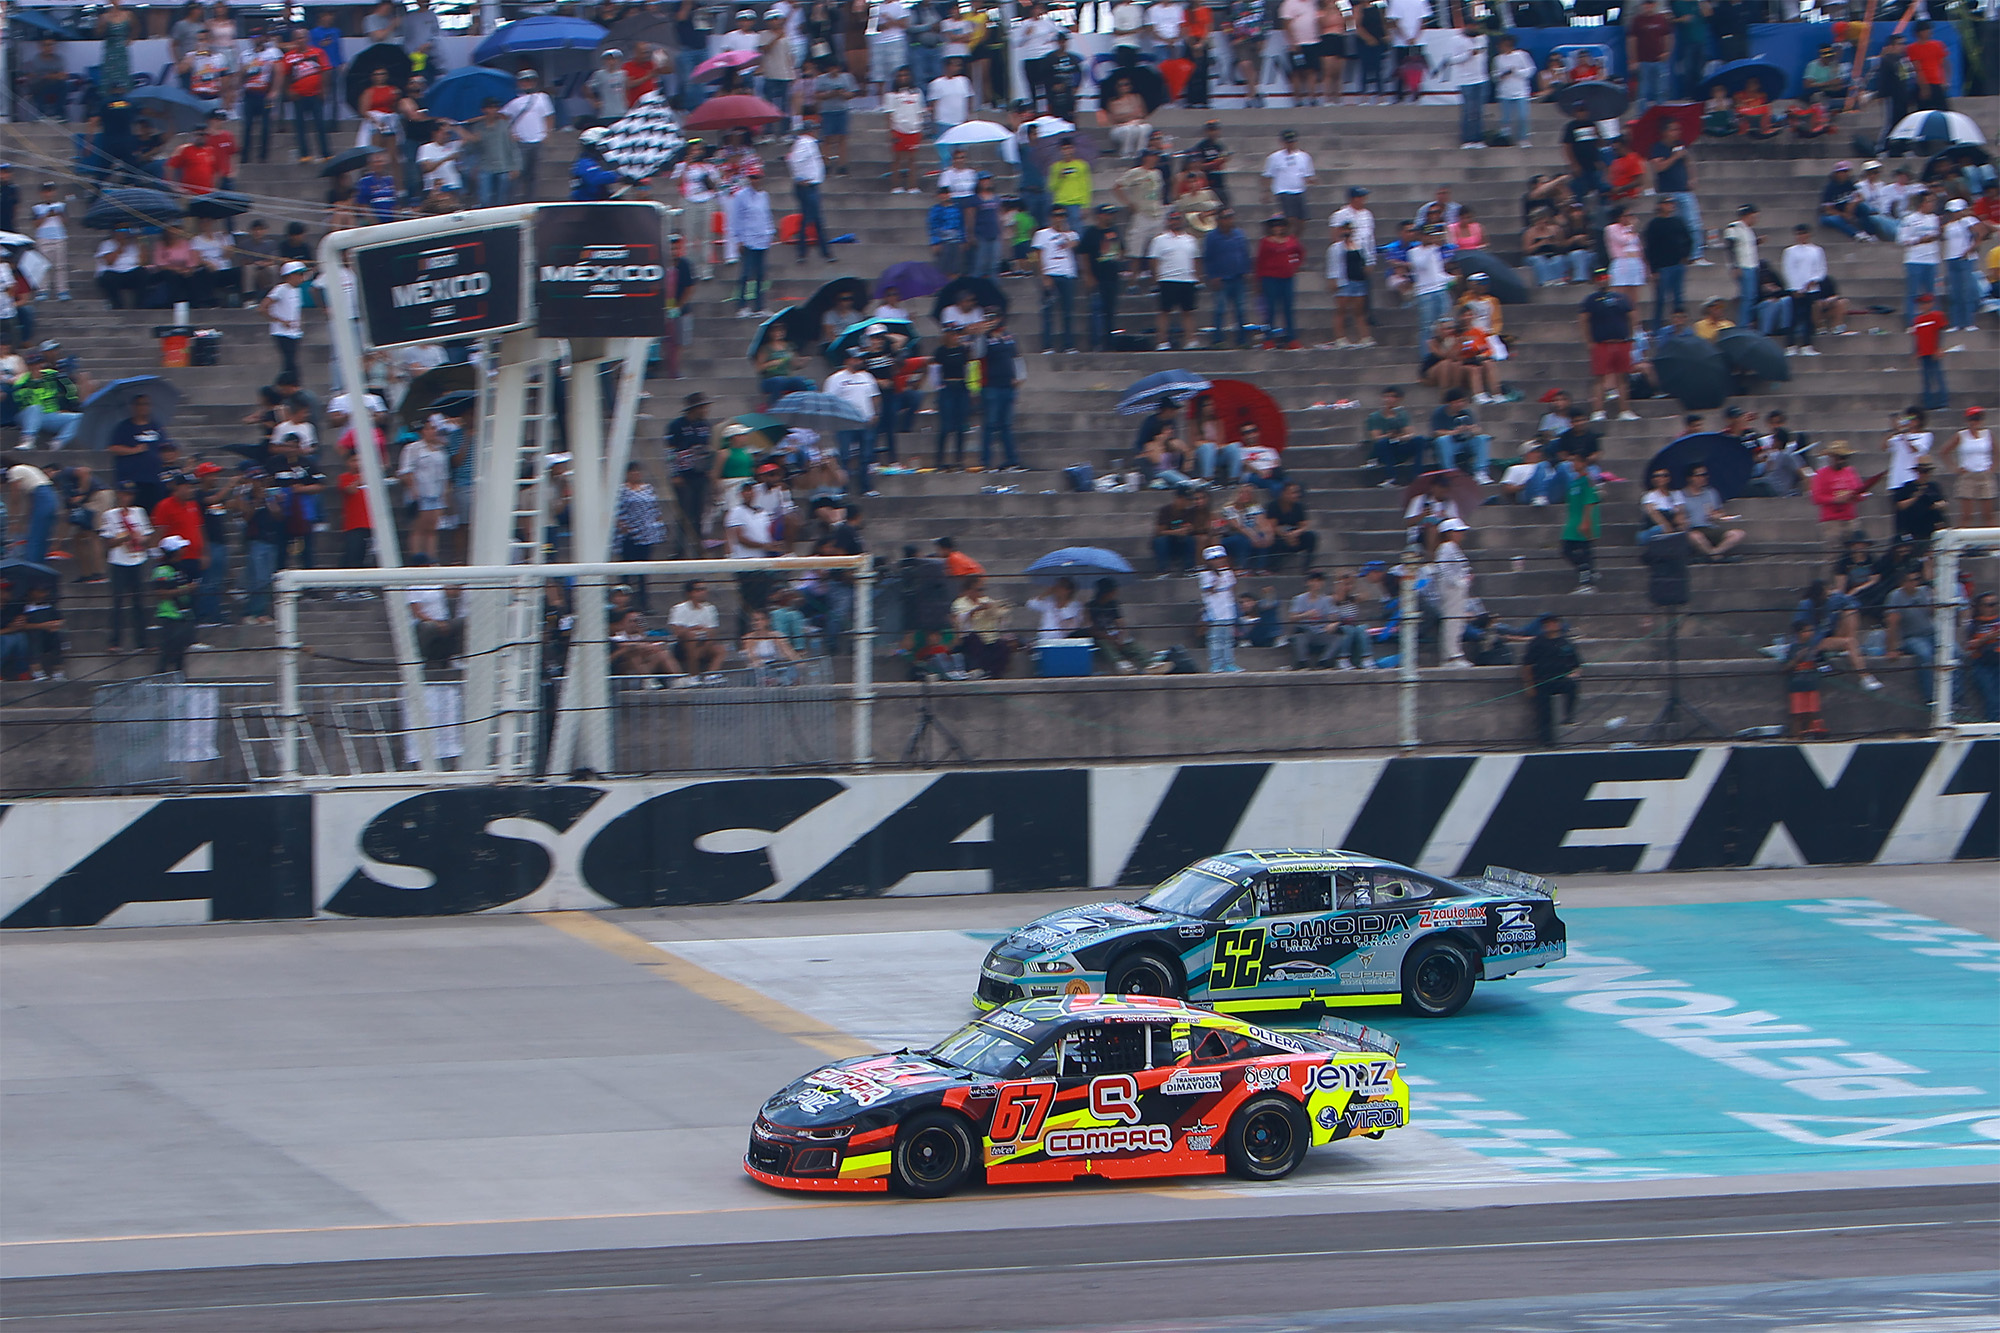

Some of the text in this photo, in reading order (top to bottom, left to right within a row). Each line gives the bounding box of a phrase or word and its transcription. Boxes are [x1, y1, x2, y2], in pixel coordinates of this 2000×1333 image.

[540, 260, 664, 281] MÉXICO
[391, 271, 491, 307] MÉXICO
[0, 738, 2000, 928] ASCALIEN
[1432, 906, 1487, 919] zauto.mx
[1270, 914, 1411, 938] OMODA
[1496, 931, 1537, 942] MOTORS
[1270, 932, 1411, 948] SERDÁN APIZACO
[1486, 940, 1564, 957] MONZANI
[1209, 928, 1266, 991] 52
[1340, 971, 1396, 979] CUPRA
[988, 1011, 1036, 1034] NASCAR
[1166, 1081, 1219, 1092] DIMAYUGA
[1175, 1075, 1219, 1083] TRANSPORTES
[1091, 1076, 1140, 1122] Q
[988, 1081, 1058, 1144] 67
[1344, 1108, 1403, 1129] VIRDI
[1049, 1127, 1169, 1152] COMPAQ
[991, 1146, 1015, 1155] telcel
